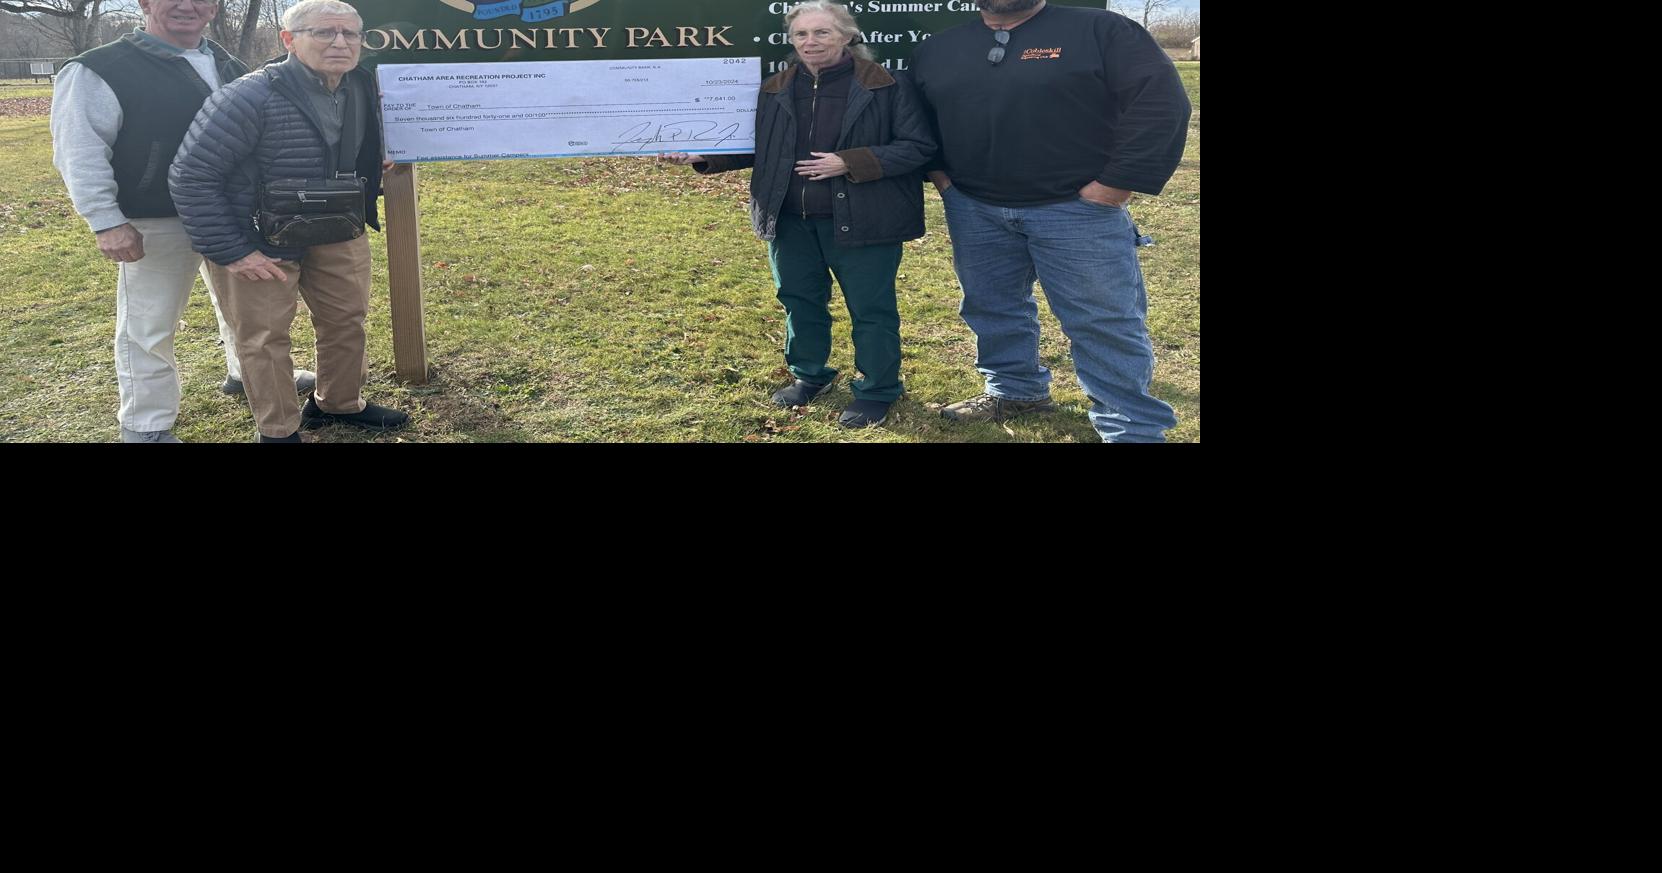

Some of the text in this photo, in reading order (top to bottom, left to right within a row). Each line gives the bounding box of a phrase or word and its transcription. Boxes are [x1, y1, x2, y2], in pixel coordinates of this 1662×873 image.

[528, 6, 559, 20] 1795
[768, 1, 863, 15] Chn's
[867, 0, 943, 13] Summer
[363, 26, 734, 50] OMMUNITY PARK
[482, 112, 511, 121] forty-one
